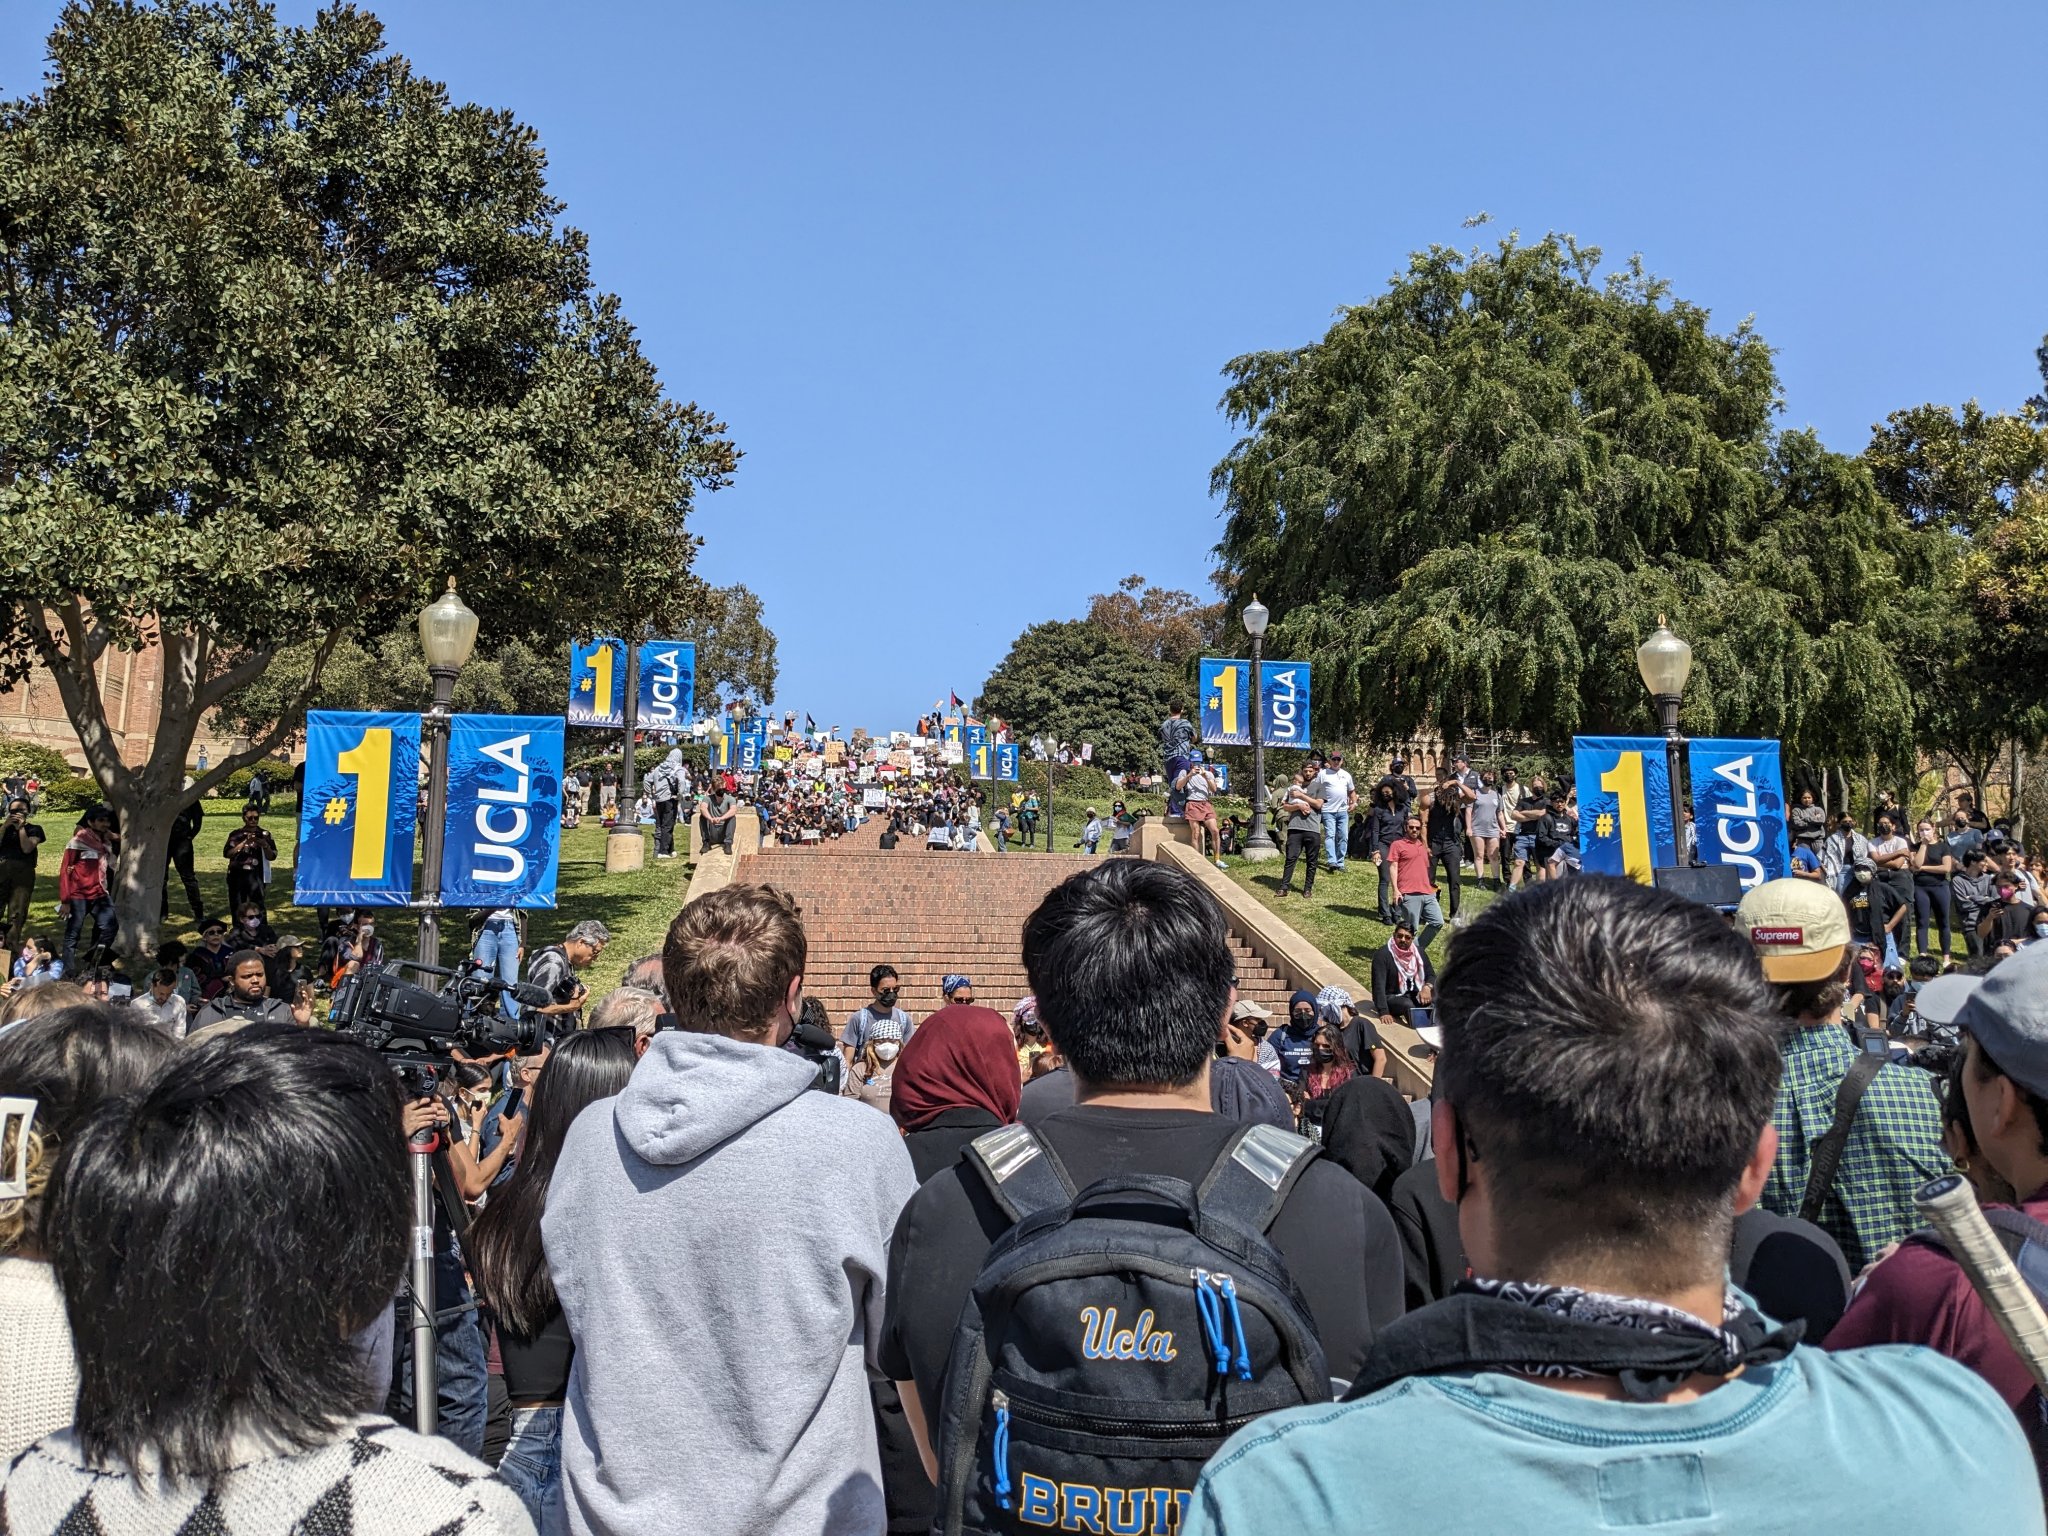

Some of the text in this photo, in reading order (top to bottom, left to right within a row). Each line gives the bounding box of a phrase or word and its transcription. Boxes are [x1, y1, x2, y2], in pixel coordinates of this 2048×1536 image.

[580, 645, 613, 717] #1
[651, 649, 679, 720] UCLA
[1209, 666, 1237, 734] #1
[1273, 669, 1296, 738] UCLA
[743, 736, 756, 768] UCLA
[1001, 747, 1012, 777] UCLA
[323, 728, 392, 880] #1
[471, 734, 530, 883] UCLA
[1595, 751, 1654, 887] #1
[1712, 755, 1765, 888] UCLA
[1755, 929, 1800, 941] Supreme
[1806, 1139, 1836, 1205] Supreme
